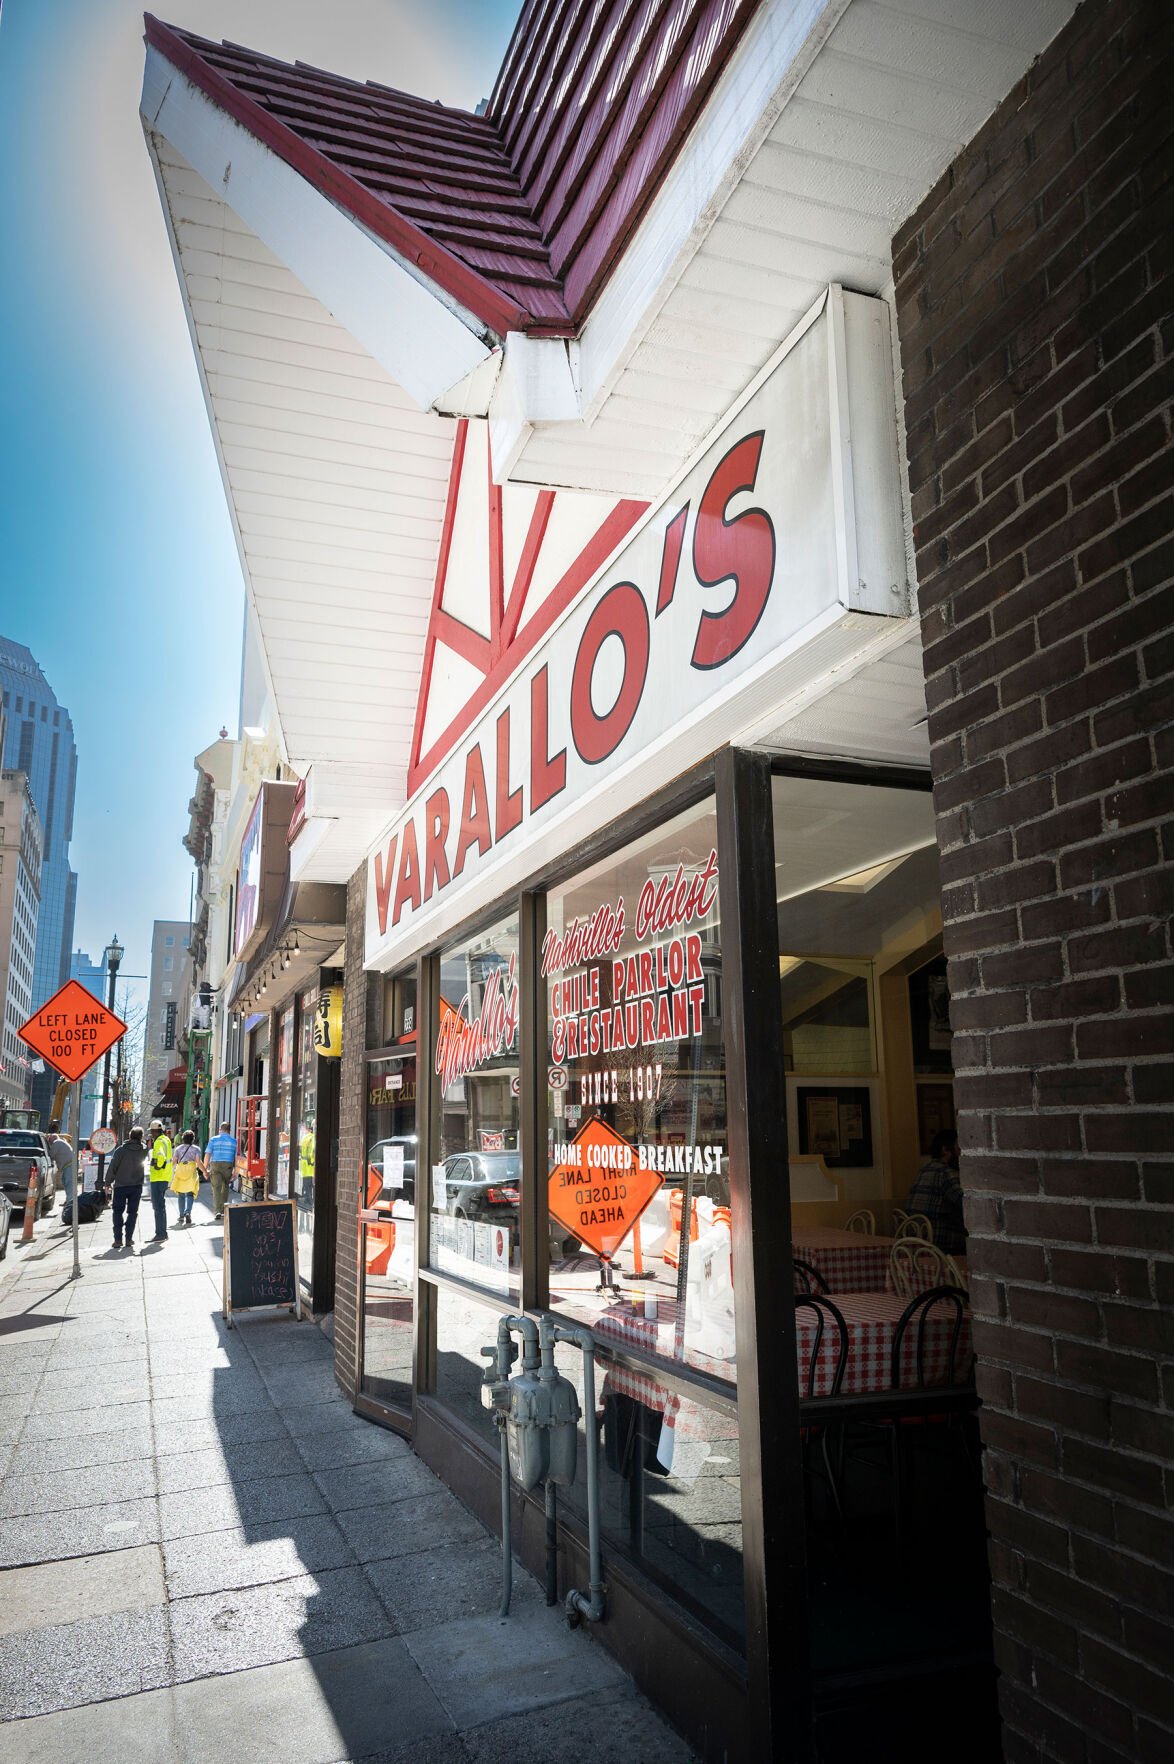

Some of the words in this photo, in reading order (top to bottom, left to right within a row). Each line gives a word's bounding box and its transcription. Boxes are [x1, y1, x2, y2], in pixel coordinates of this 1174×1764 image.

[375, 430, 776, 937] VARALLO'S
[541, 896, 625, 978] Nashville's
[635, 848, 719, 941] Oldest
[551, 967, 599, 1019] CHILE
[613, 933, 704, 1004] PARLOR
[39, 1014, 68, 1027] LEFT
[75, 1013, 107, 1025] LANE
[49, 1028, 97, 1042] CLOSED
[51, 1044, 72, 1057] 100
[81, 1043, 96, 1056] FT
[581, 1070, 618, 1105] SINCE
[630, 1064, 662, 1102] 1907
[554, 1144, 582, 1167] HOME
[587, 1144, 632, 1170] COOKED
[639, 1145, 723, 1174] BREAKFAST
